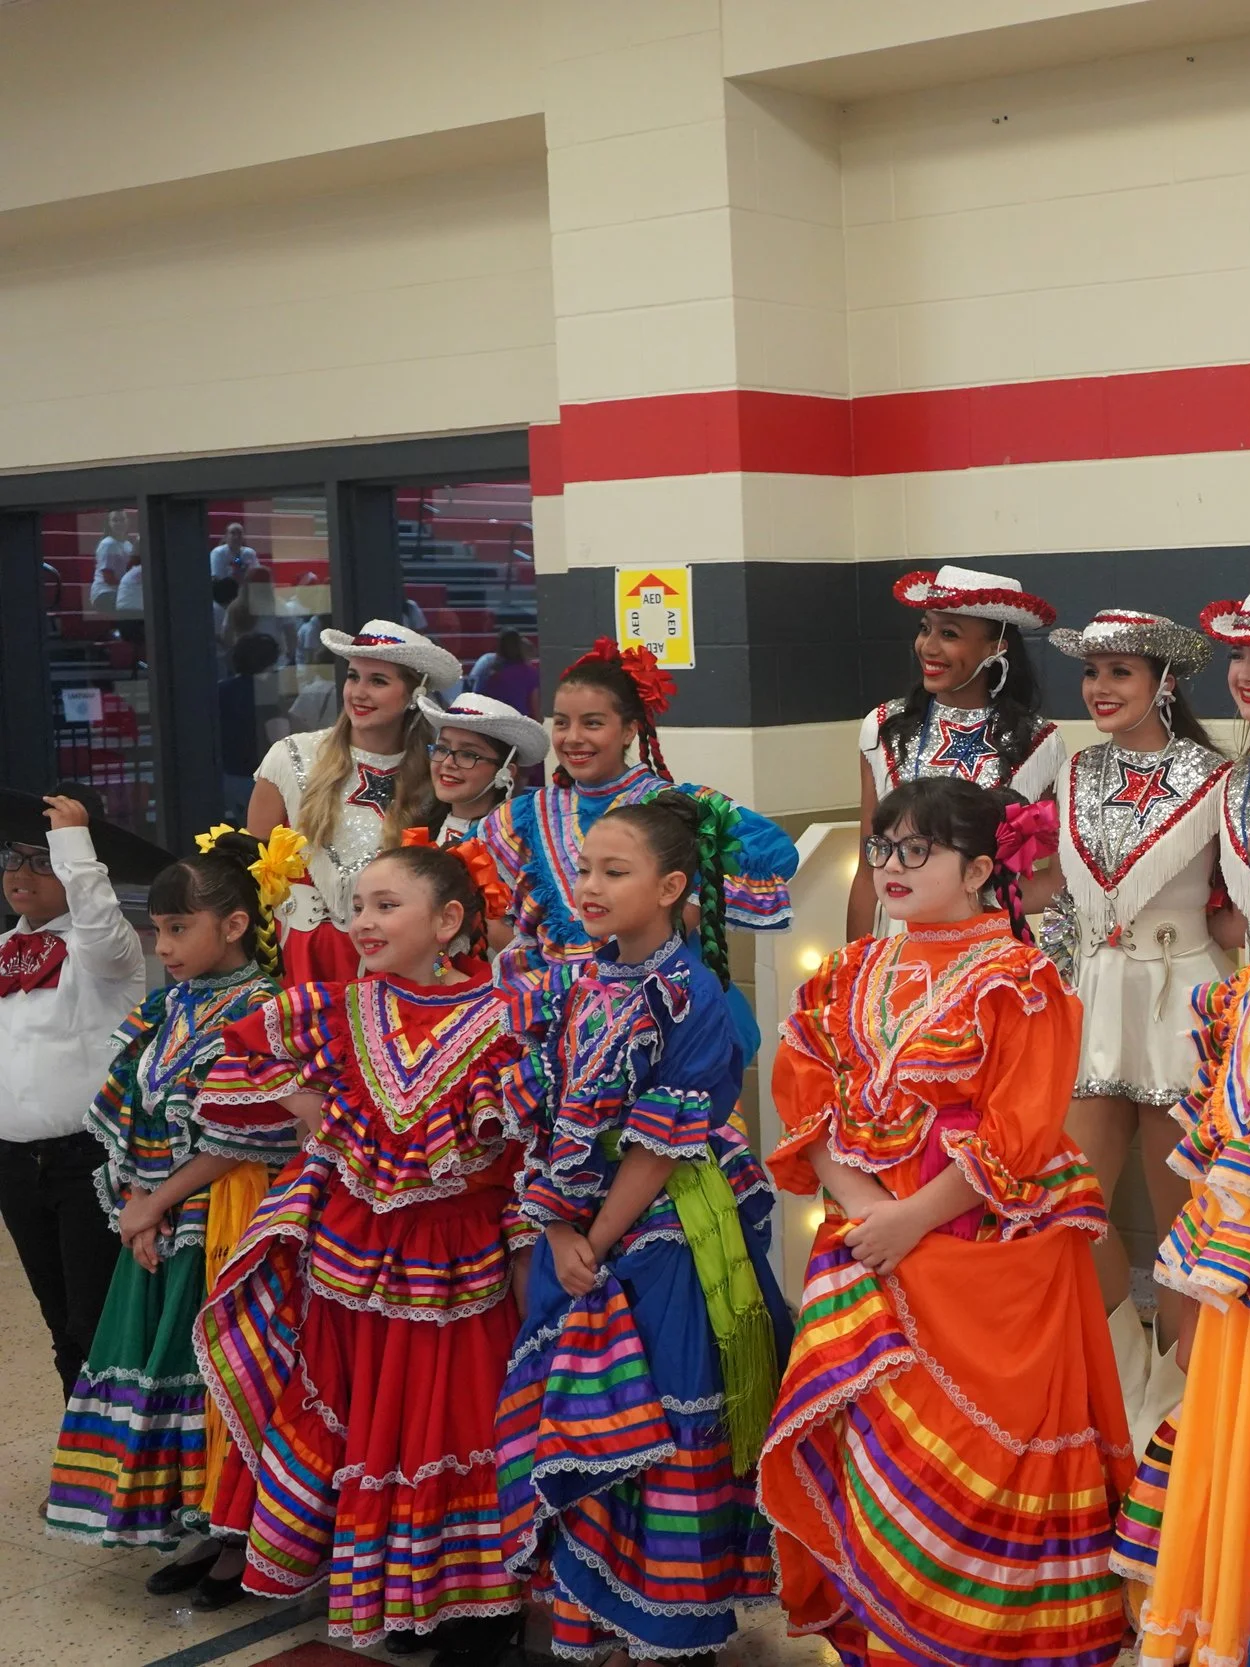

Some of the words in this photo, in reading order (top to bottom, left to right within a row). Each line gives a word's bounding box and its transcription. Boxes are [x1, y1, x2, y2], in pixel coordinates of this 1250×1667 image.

[642, 593, 662, 604] AED
[631, 611, 641, 636] AED
[667, 610, 676, 635] AED
